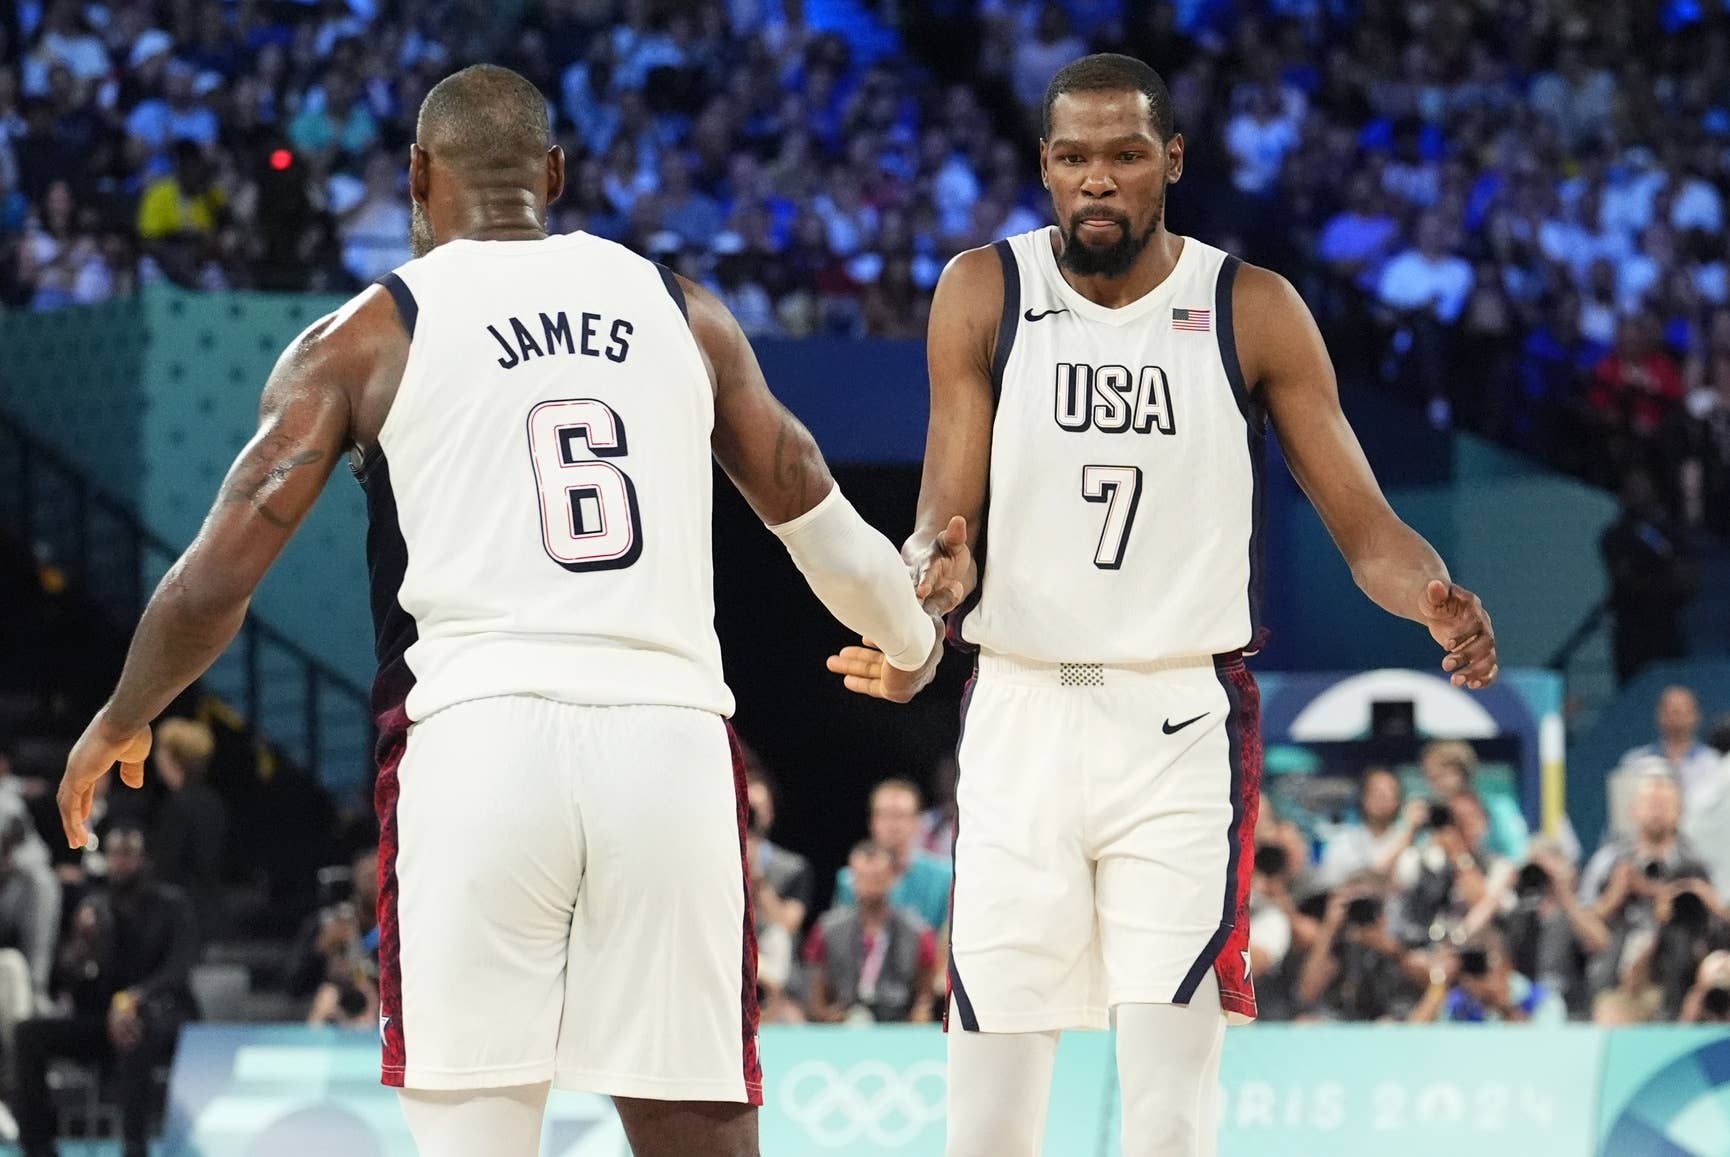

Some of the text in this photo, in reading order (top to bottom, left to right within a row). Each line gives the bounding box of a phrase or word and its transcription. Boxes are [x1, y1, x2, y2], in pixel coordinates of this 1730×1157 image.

[486, 311, 634, 370] JAMES
[1054, 362, 1176, 435] USA
[526, 397, 644, 573] 6
[1081, 464, 1143, 570] 7
[1218, 1079, 1555, 1133] RIS 2024
